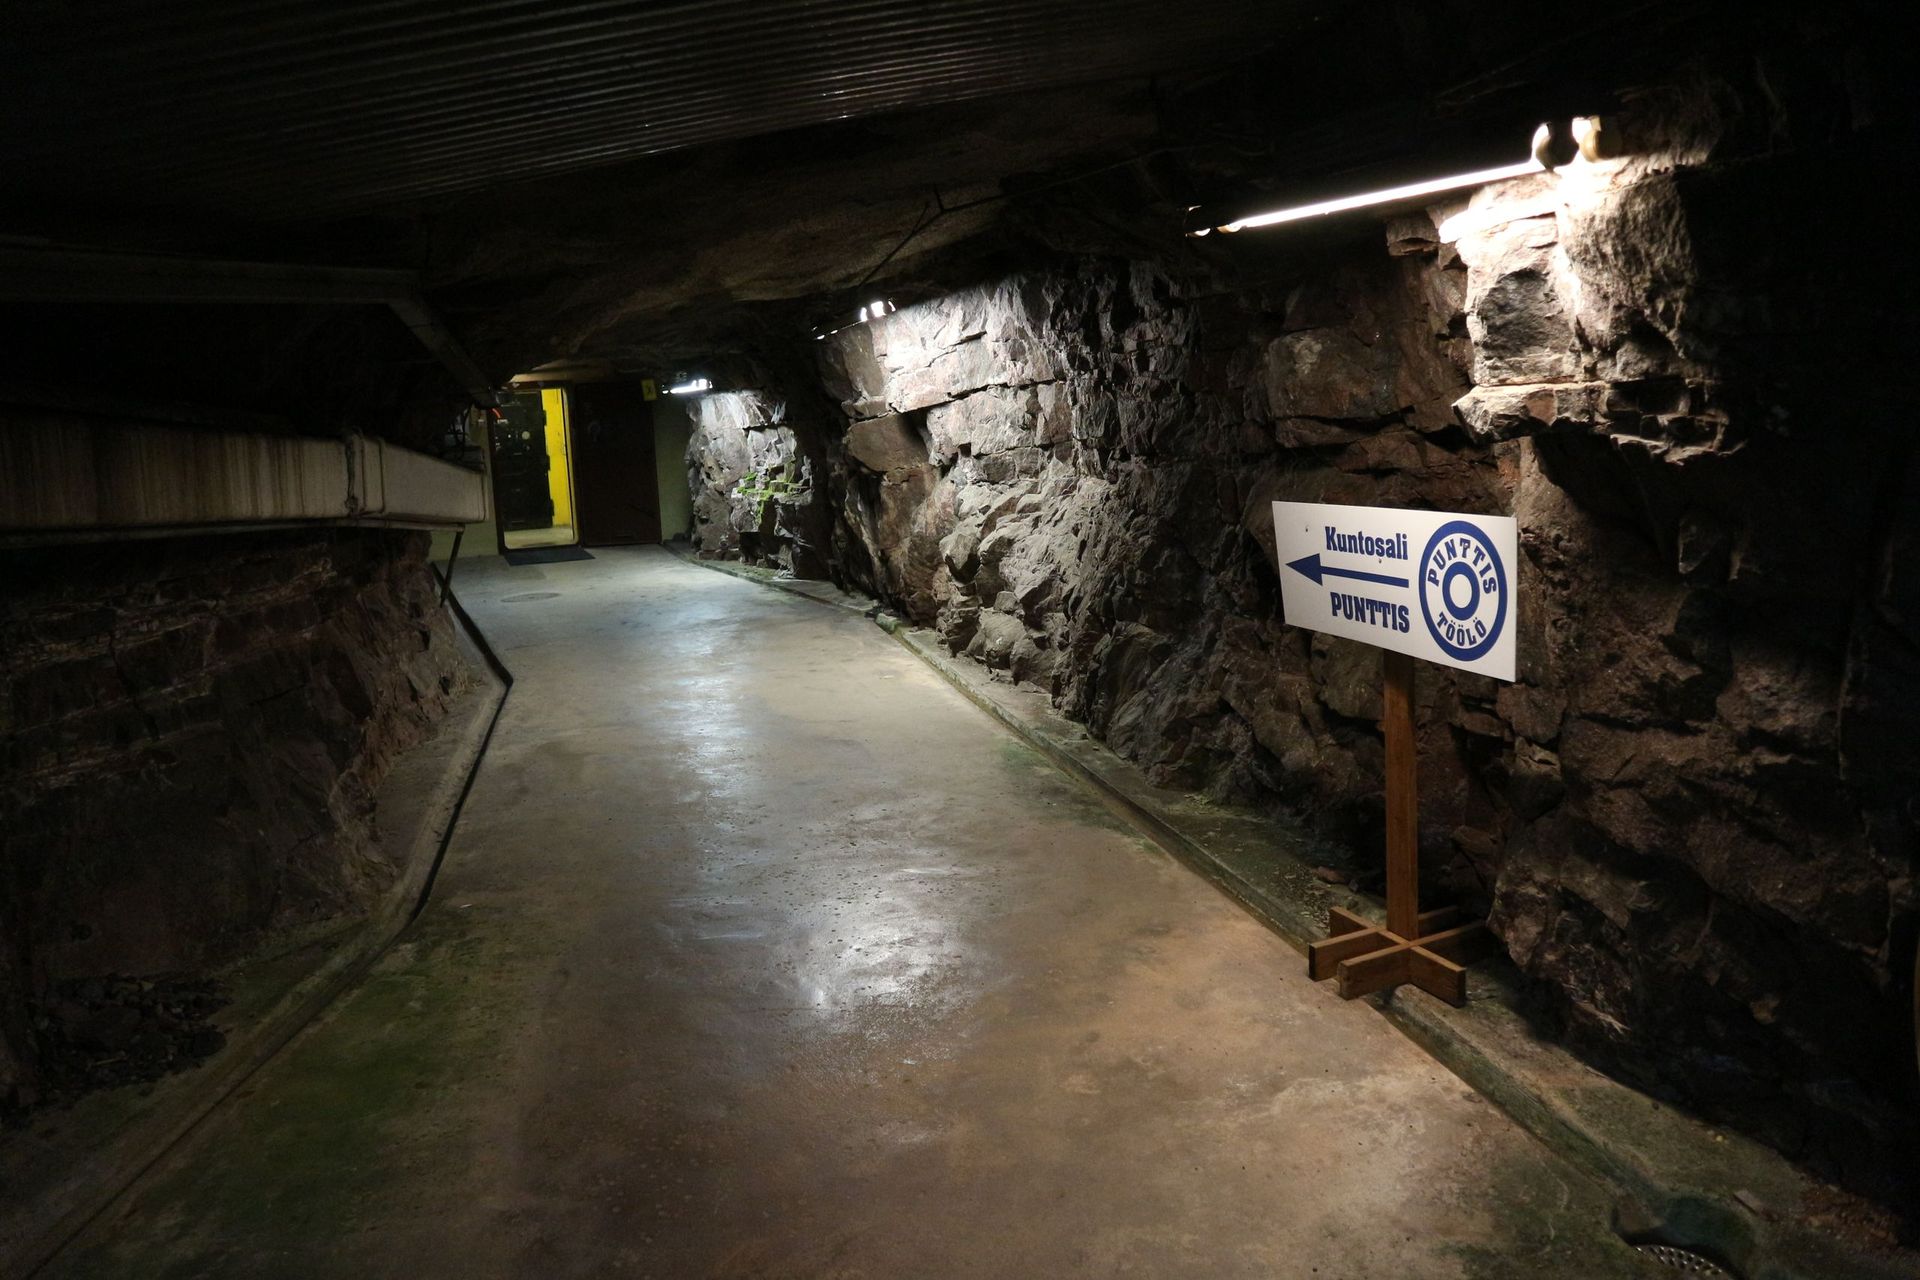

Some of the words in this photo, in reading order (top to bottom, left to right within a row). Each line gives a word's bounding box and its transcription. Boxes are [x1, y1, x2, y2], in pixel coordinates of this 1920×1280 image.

[1325, 526, 1408, 560] Kuntosali
[1428, 537, 1497, 594] PUNTTIS
[1330, 592, 1410, 633] PUNTTIS
[1436, 611, 1487, 647] TÖÖLÖ
